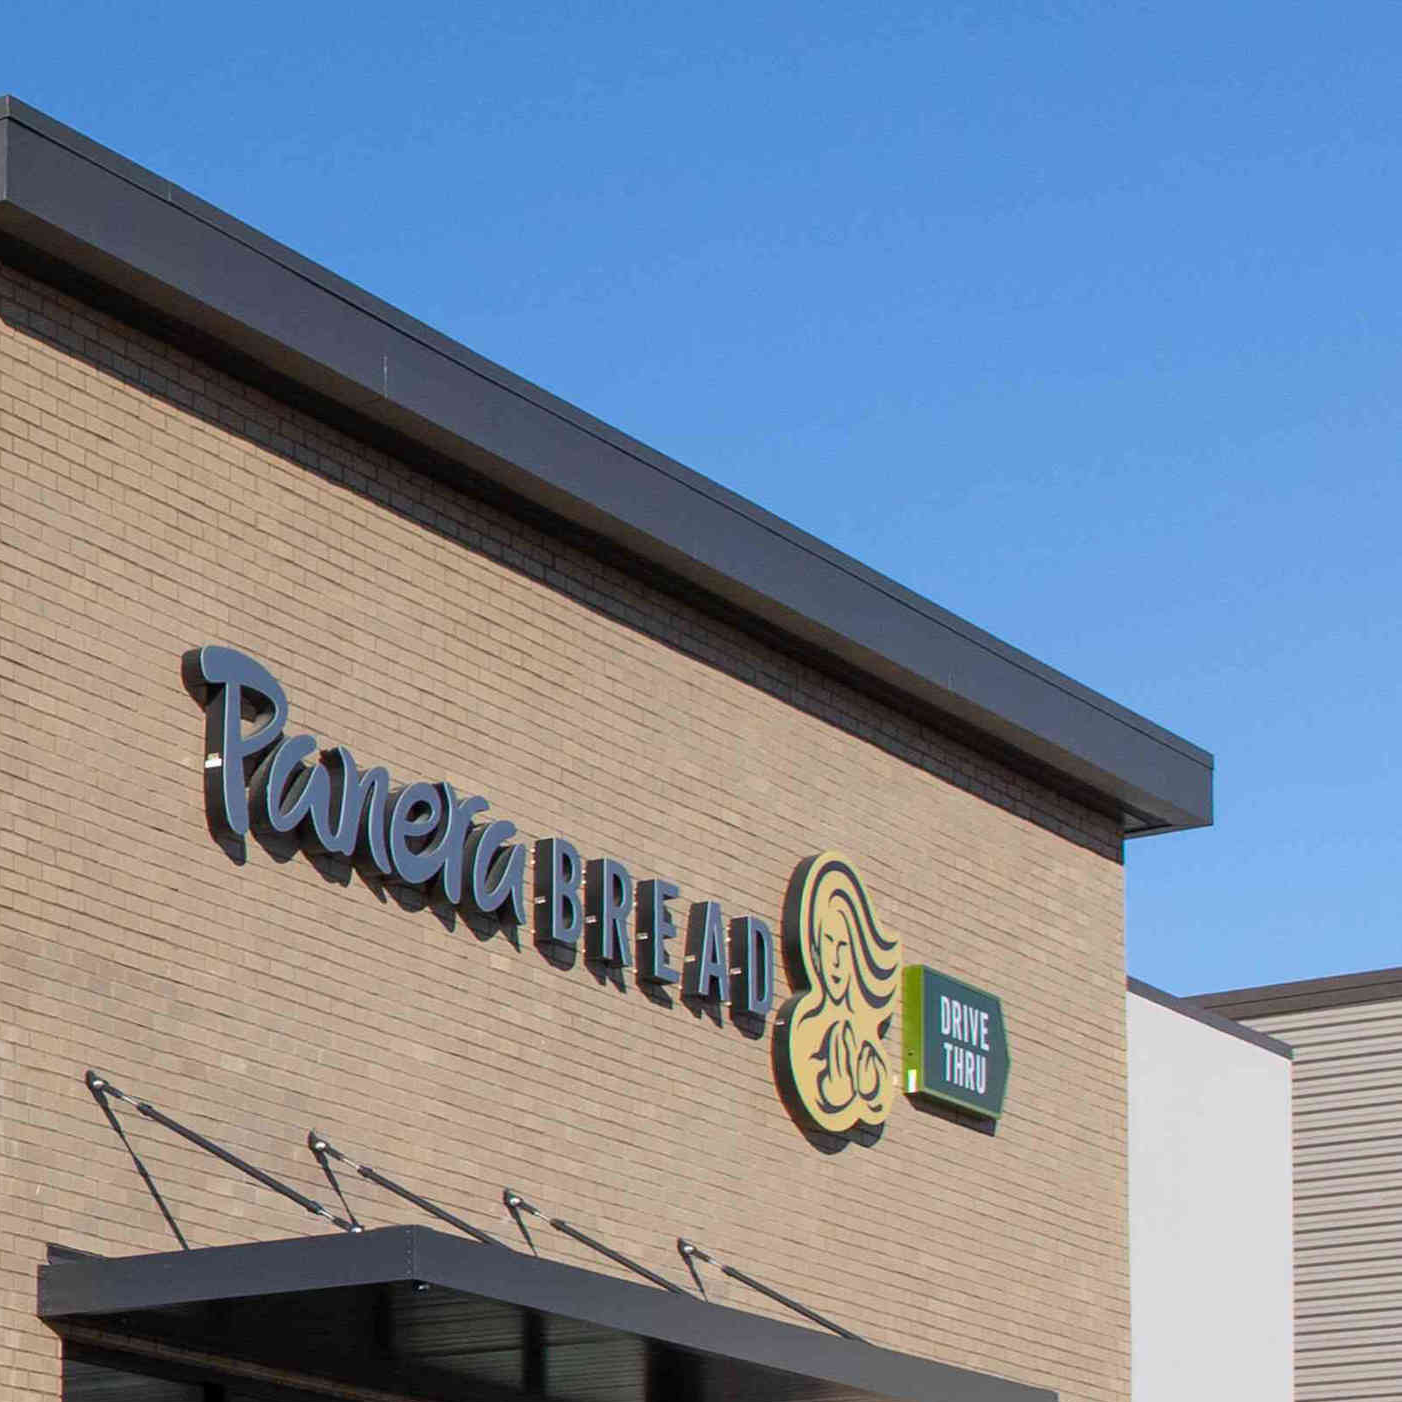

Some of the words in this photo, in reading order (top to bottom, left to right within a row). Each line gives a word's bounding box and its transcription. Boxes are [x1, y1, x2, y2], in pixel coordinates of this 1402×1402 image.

[198, 644, 528, 926] Panera
[546, 837, 776, 1018] BREAD
[939, 995, 991, 1051] DRIVE
[942, 1041, 987, 1095] THRU
